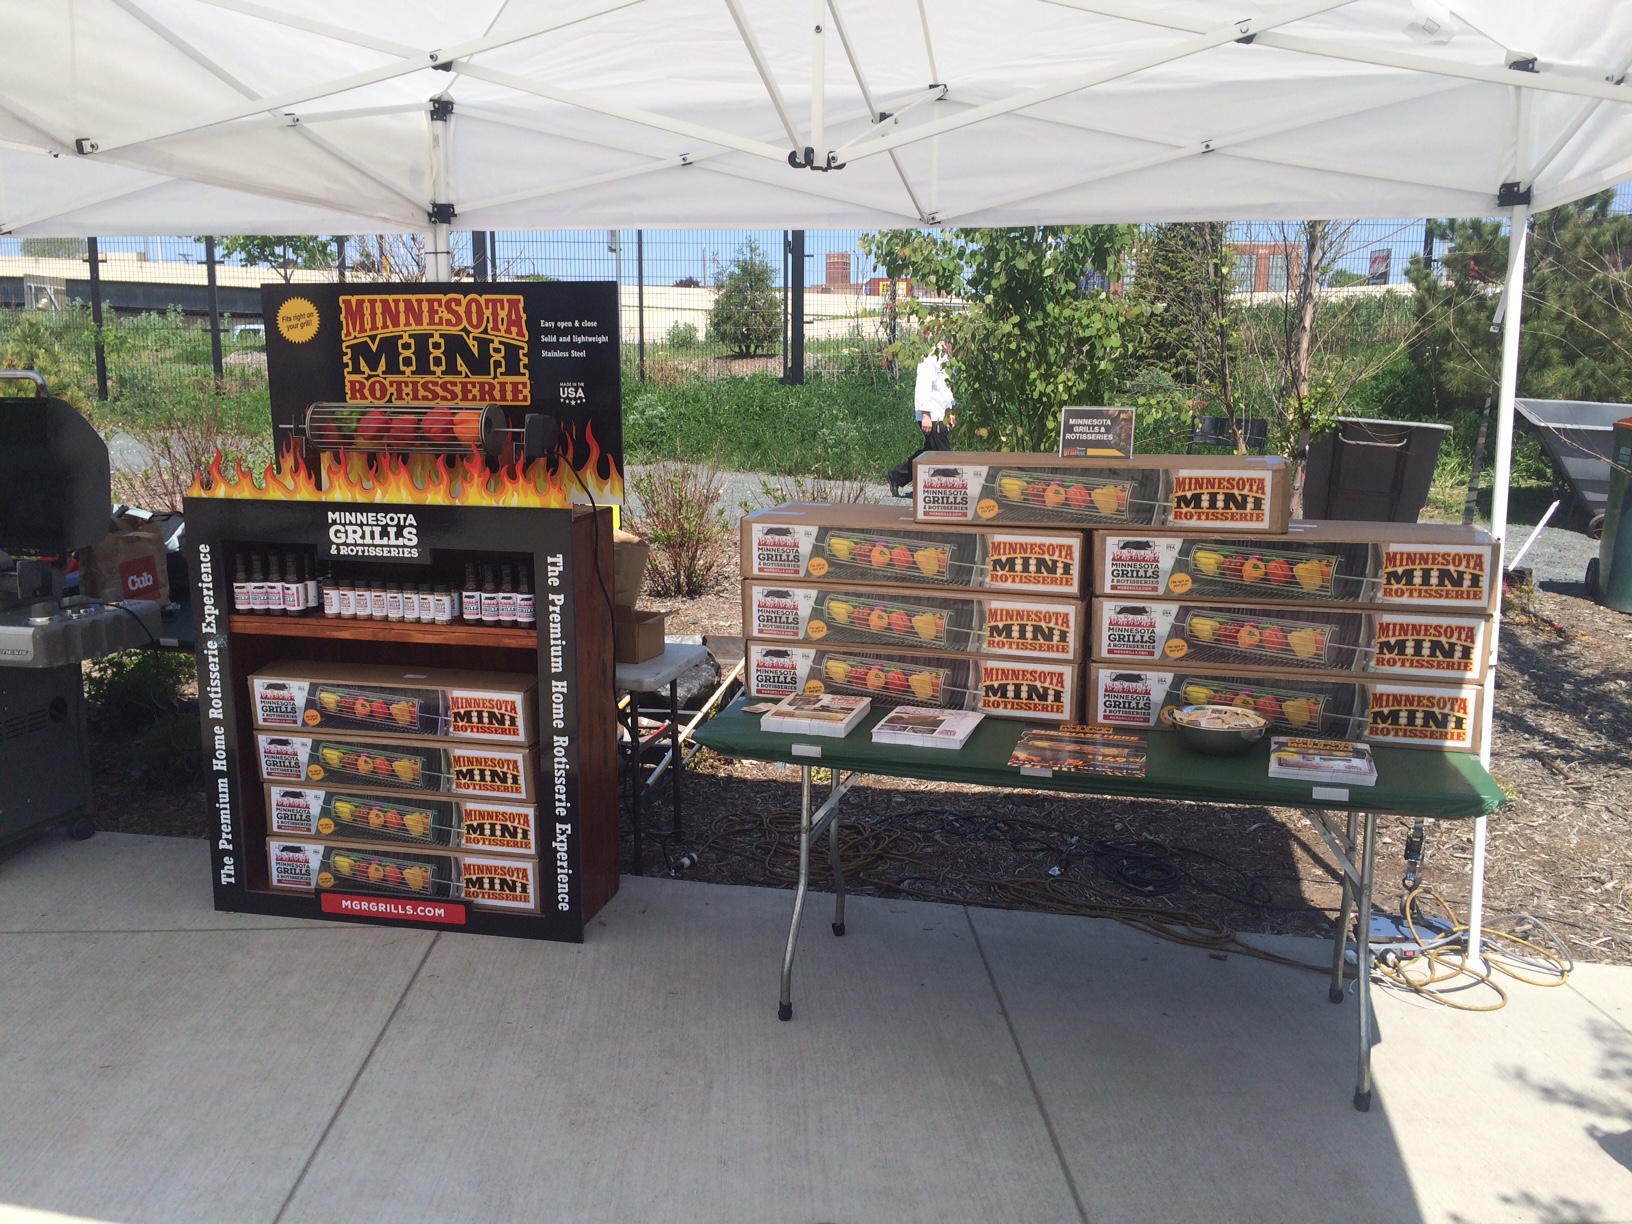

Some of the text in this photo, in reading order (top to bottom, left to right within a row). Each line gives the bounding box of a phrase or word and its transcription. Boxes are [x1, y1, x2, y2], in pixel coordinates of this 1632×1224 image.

[282, 315, 292, 323] Fits
[292, 314, 306, 322] right
[286, 320, 313, 331] your grill!
[340, 296, 527, 340] MINNESOTA
[540, 320, 557, 328] Easy
[572, 335, 609, 344] lightweight
[344, 331, 528, 378] MINI
[347, 379, 529, 403] ROTISSERIE
[560, 387, 585, 398] USA
[1174, 477, 1266, 495] MINNESOTA
[923, 496, 968, 505] GRILLS
[1174, 492, 1265, 510] MINI
[328, 511, 417, 526] MINNESOTA
[1174, 511, 1264, 522] ROTISSERIE
[329, 525, 418, 546] GRILLS
[330, 544, 418, 557] & ROTISSERIES
[758, 553, 800, 563] GRILLS
[990, 542, 1073, 560] MINNESOTA
[991, 556, 1073, 575] MINI
[1384, 552, 1483, 572] MINNESOTA
[128, 572, 153, 590] Cub
[990, 574, 1073, 586] ROTISSERIE
[1111, 569, 1160, 579] GRILLS
[1384, 568, 1483, 588] MINI
[1383, 588, 1482, 599] ROTISSERIE
[758, 615, 799, 625] GRILLS
[987, 608, 1070, 628] MINNESOTA
[986, 624, 1070, 642] MINI
[1108, 634, 1156, 644] GRILLS
[1377, 623, 1475, 644] MINNESOTA
[987, 640, 1069, 653] ROTISSERIE
[1377, 639, 1473, 659] MINI
[1375, 657, 1473, 672] ROTISSERIE
[756, 675, 797, 685] GRILLS
[983, 668, 1064, 688] MINNESOTA
[983, 683, 1064, 703] MINI
[262, 706, 297, 715] GRILLS
[450, 696, 517, 715] MINNESOTA
[982, 699, 1064, 714] ROTISSERIE
[1104, 700, 1151, 711] GRILLS
[1371, 693, 1468, 715] MINNESOTA
[198, 544, 235, 885] The Premium Home Rotisserie Experience
[452, 710, 518, 727] MINI
[1371, 709, 1466, 730] MINI
[452, 724, 520, 736] ROTISSERIE
[547, 554, 572, 912] The Premium Home Rotisserie Experience
[1031, 730, 1101, 738] PURCHASE
[1369, 726, 1466, 741] ROTISSERIE
[265, 760, 300, 769] GRILLS
[452, 755, 520, 773] MINNESOTA
[454, 768, 520, 785] MINI
[455, 781, 522, 794] ROTISSERIE
[276, 813, 311, 822] GRILLS
[464, 809, 530, 828] MINNESOTA
[465, 823, 530, 839] MINI
[465, 837, 531, 849] ROTISSERIE
[276, 867, 311, 876] GRILLS
[463, 863, 530, 882] MINNESOTA
[464, 877, 530, 894] MINI
[464, 890, 530, 903] ROTISSERIE
[341, 899, 445, 917] MGRGRILLS.COM
